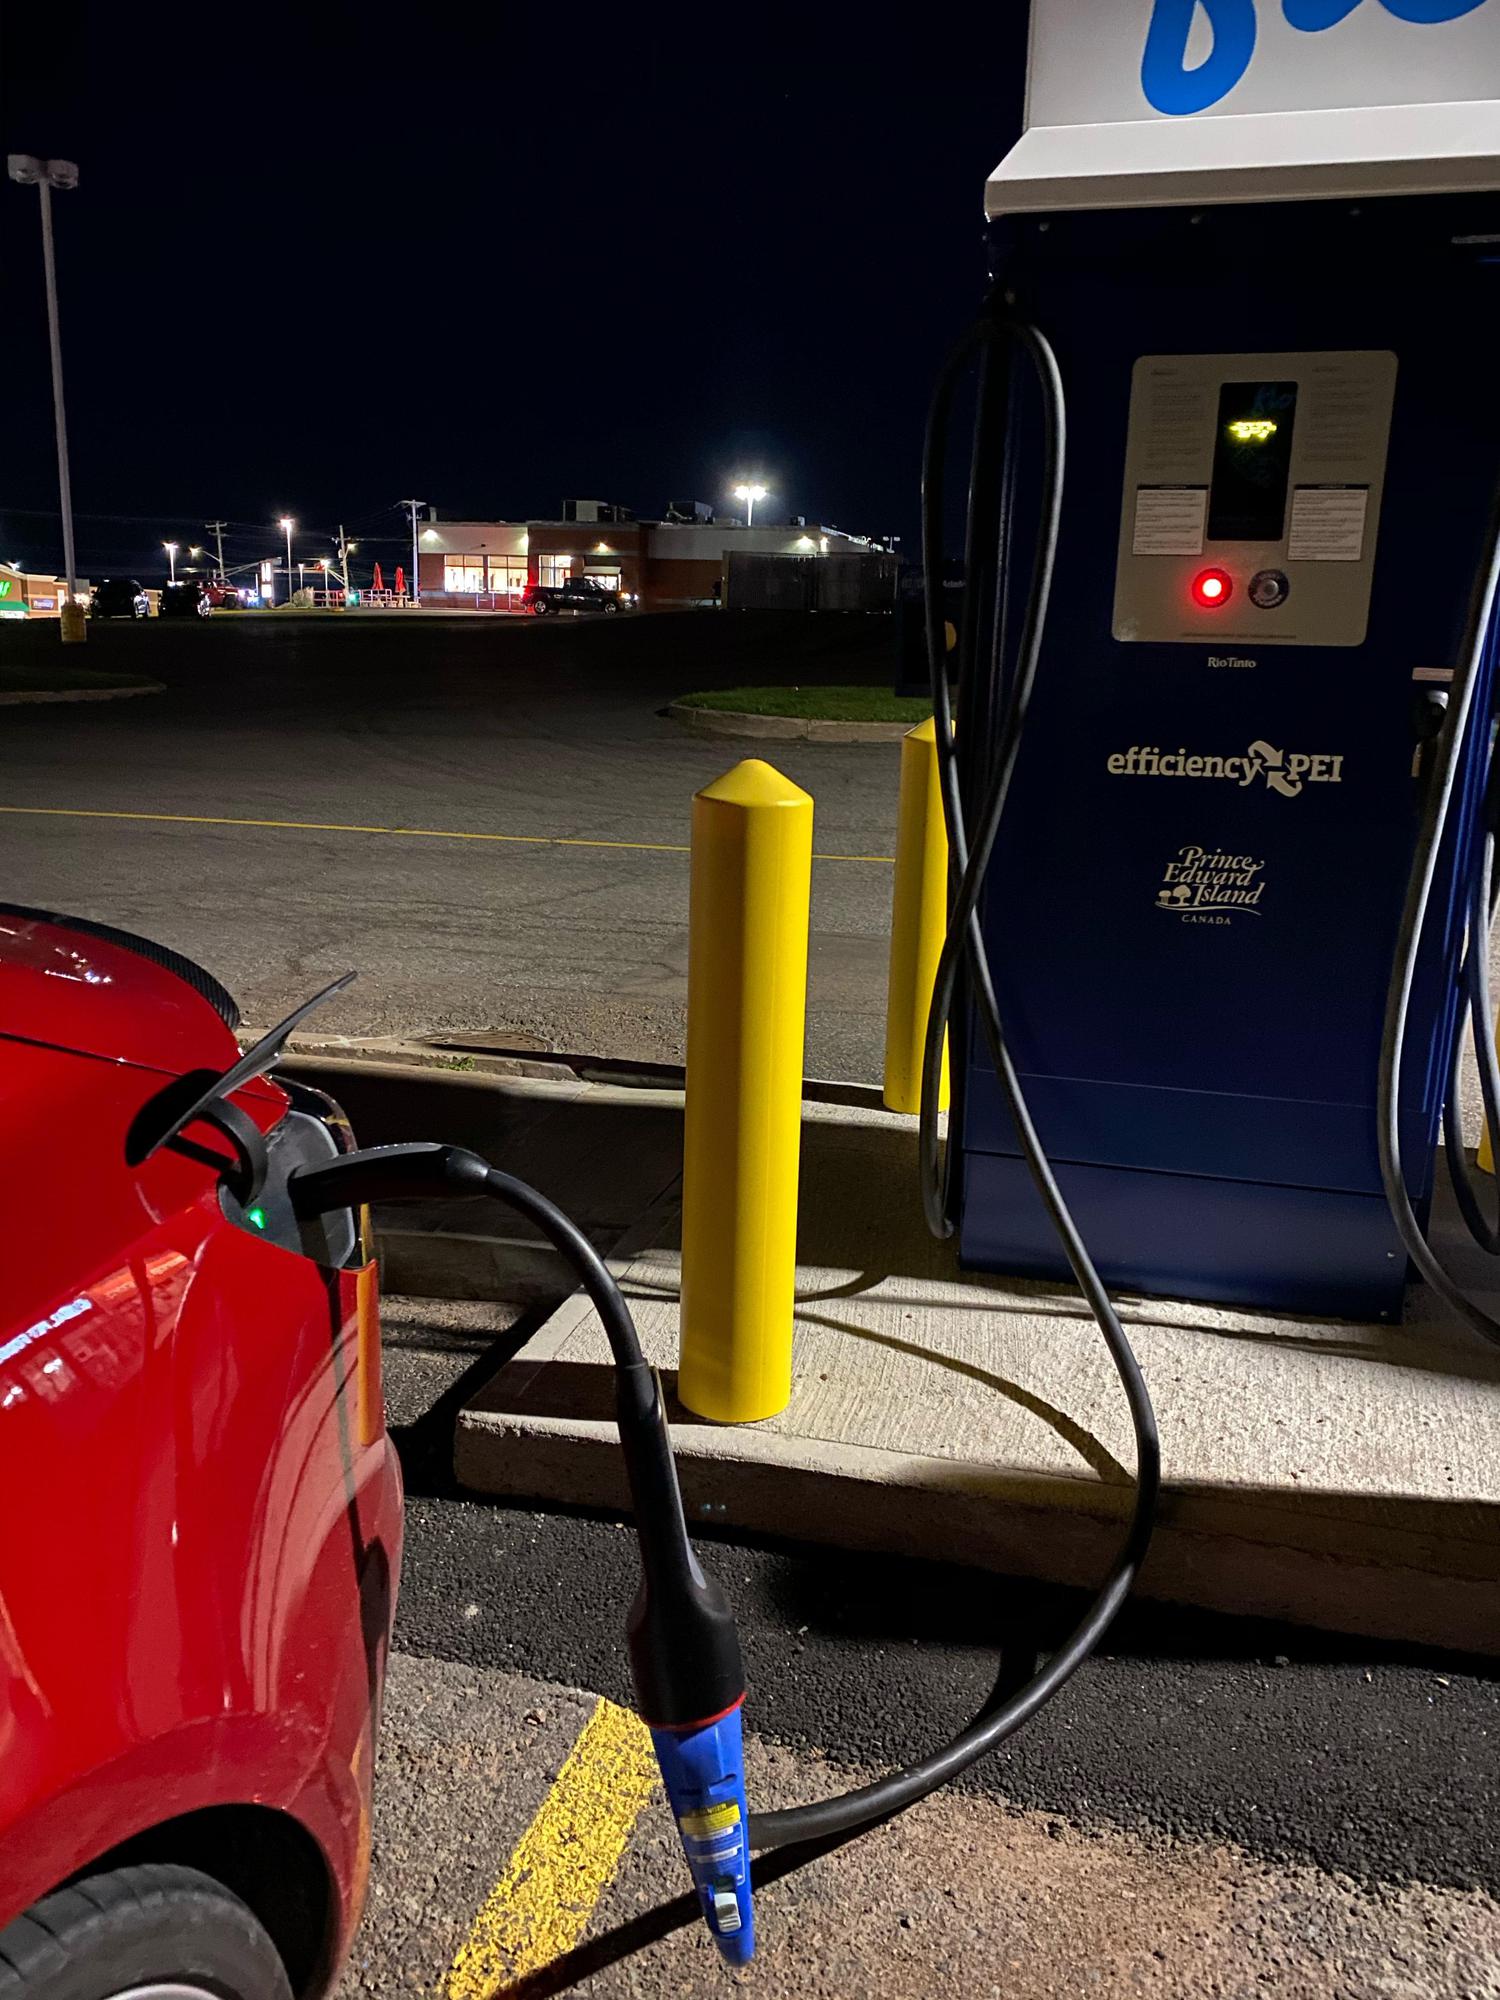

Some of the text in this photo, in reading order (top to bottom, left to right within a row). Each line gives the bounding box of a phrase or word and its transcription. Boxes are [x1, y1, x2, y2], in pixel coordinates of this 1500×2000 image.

[1107, 747, 1344, 786] efficiency PEI
[1178, 846, 1265, 871] Prince
[1163, 862, 1253, 886] Edward
[1192, 882, 1266, 906] Island
[1181, 914, 1231, 926] CANADA
